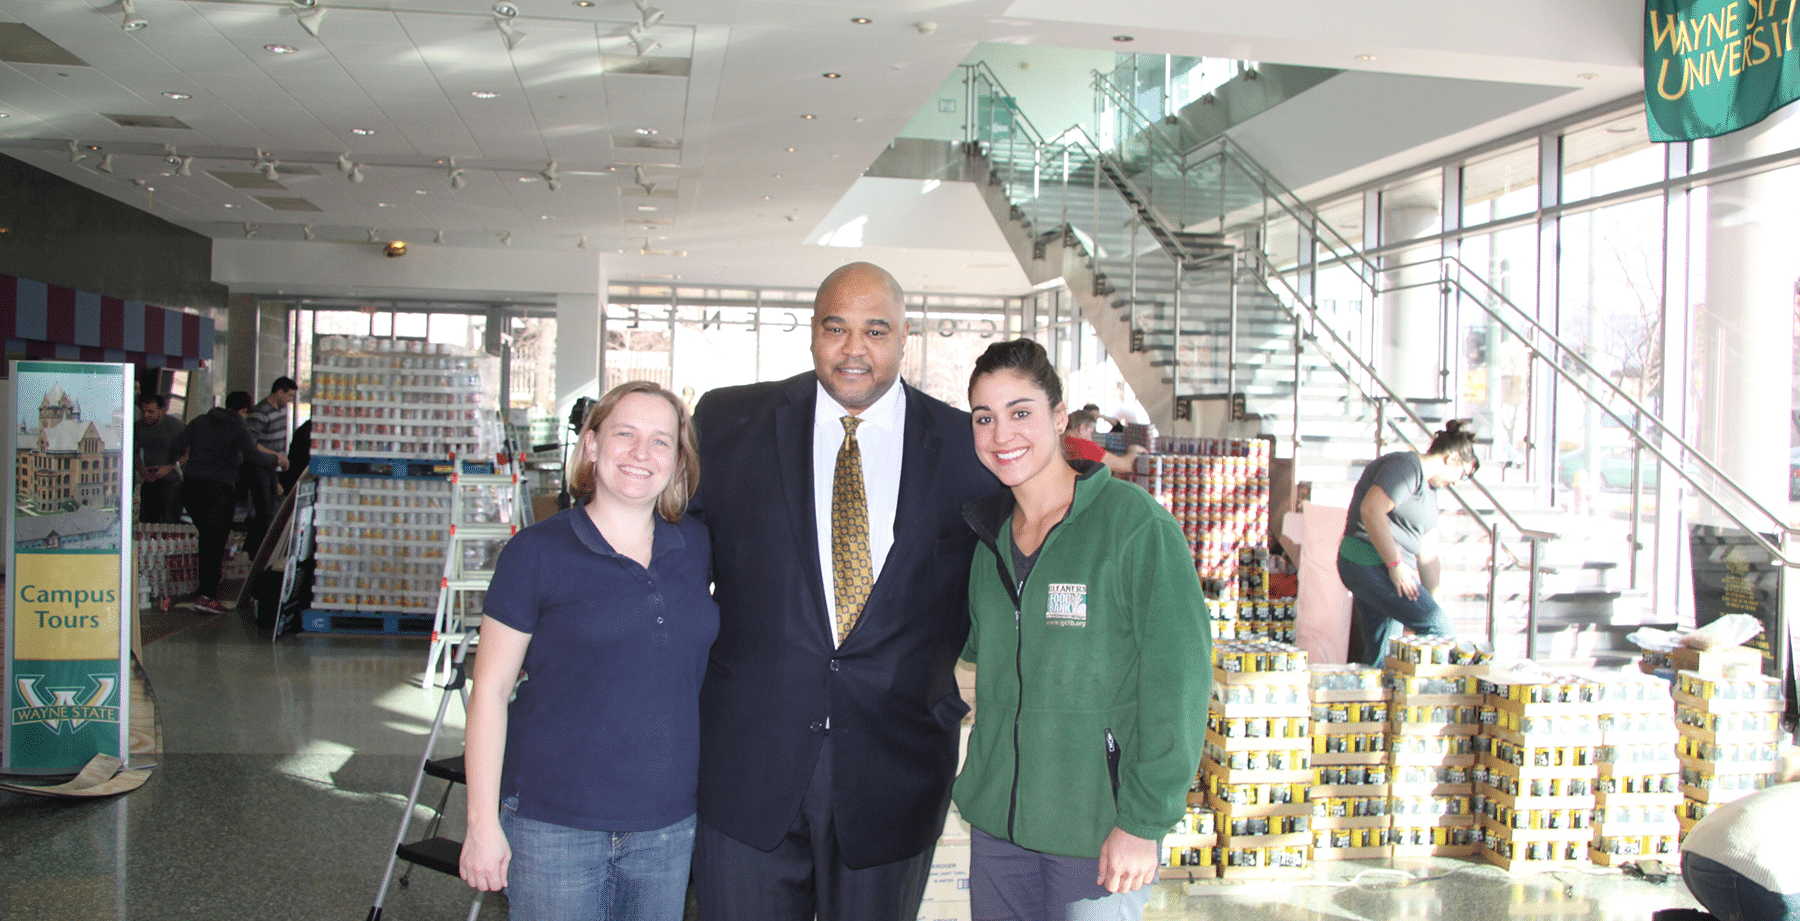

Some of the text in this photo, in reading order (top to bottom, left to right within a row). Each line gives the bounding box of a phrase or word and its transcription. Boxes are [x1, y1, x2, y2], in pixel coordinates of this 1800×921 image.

[1650, 1, 1740, 55] WAYNE
[20, 584, 116, 608] Campus
[1050, 593, 1071, 603] FOOD
[1049, 603, 1071, 613] BANK
[34, 610, 100, 628] Tours
[17, 706, 115, 721] WAYNE STATE
